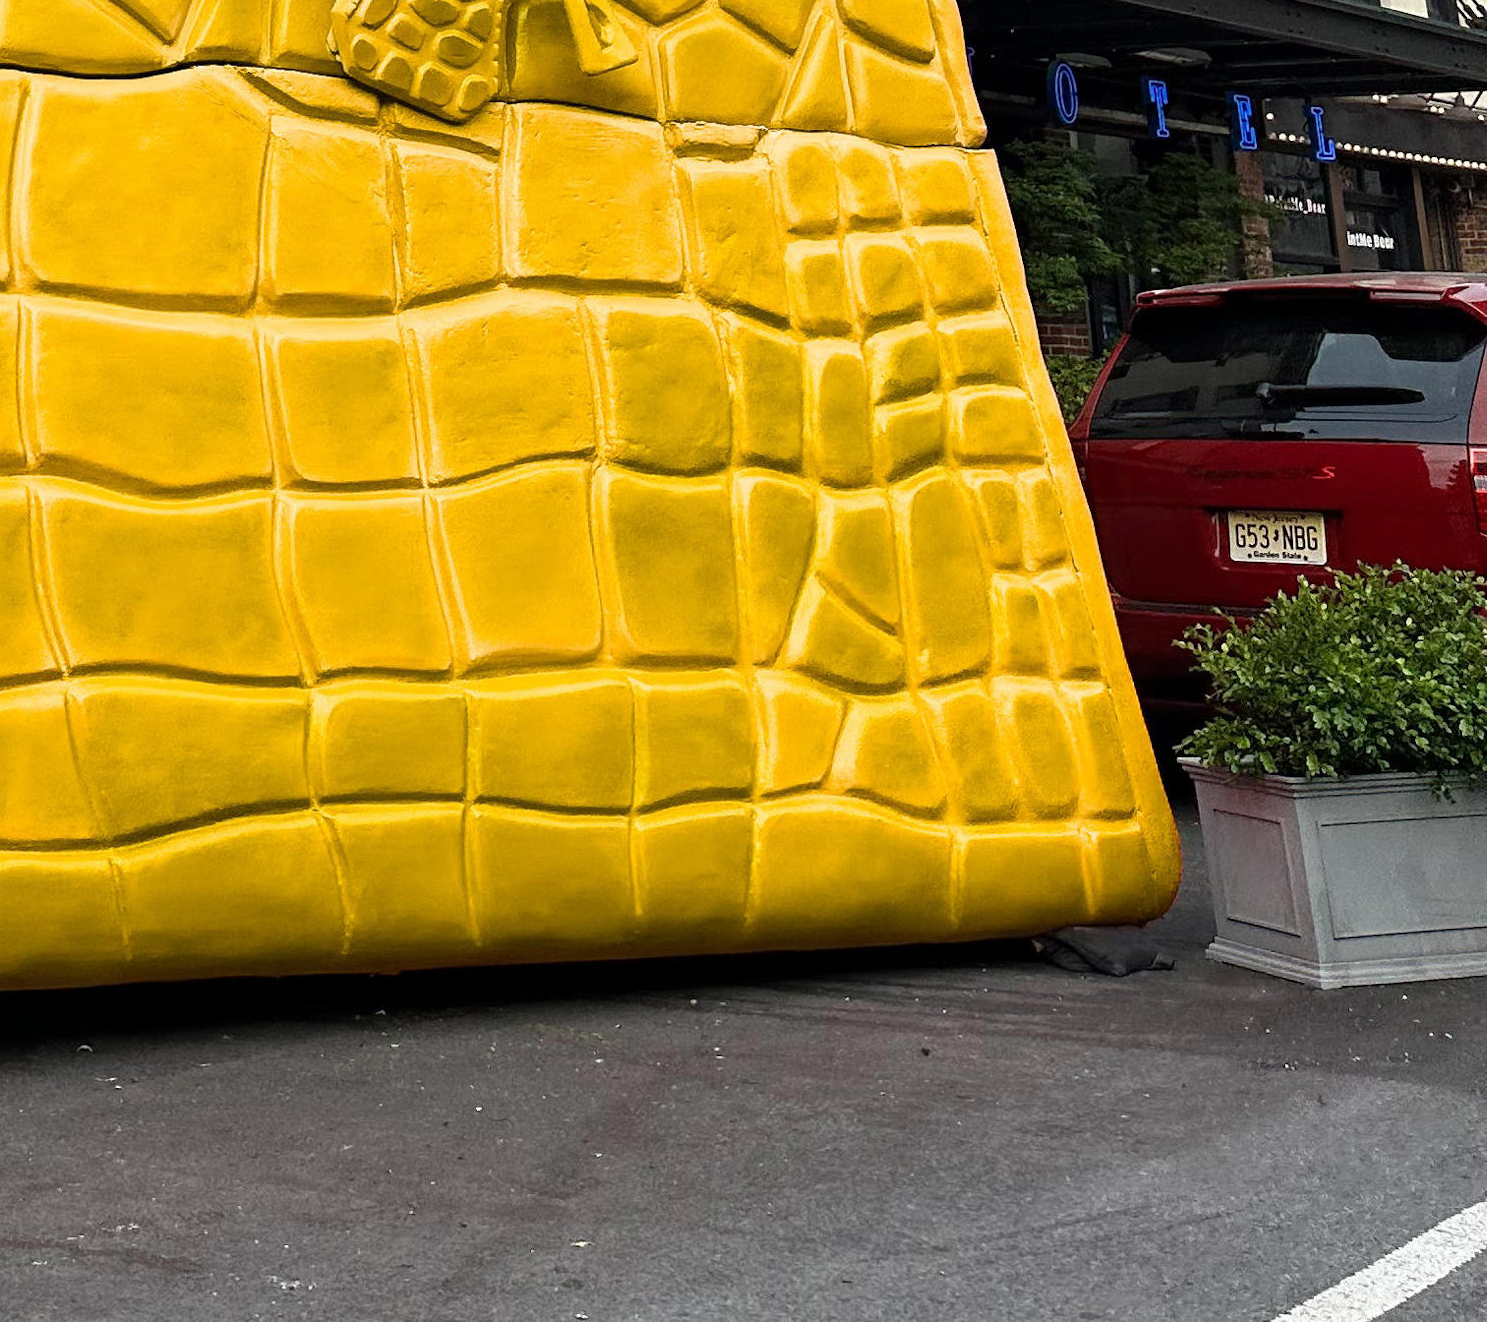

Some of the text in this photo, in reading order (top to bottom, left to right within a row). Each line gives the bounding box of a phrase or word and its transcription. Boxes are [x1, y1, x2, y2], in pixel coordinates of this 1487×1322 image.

[967, 46, 1337, 163] OTEL
[1235, 523, 1318, 551] G53 NBG
